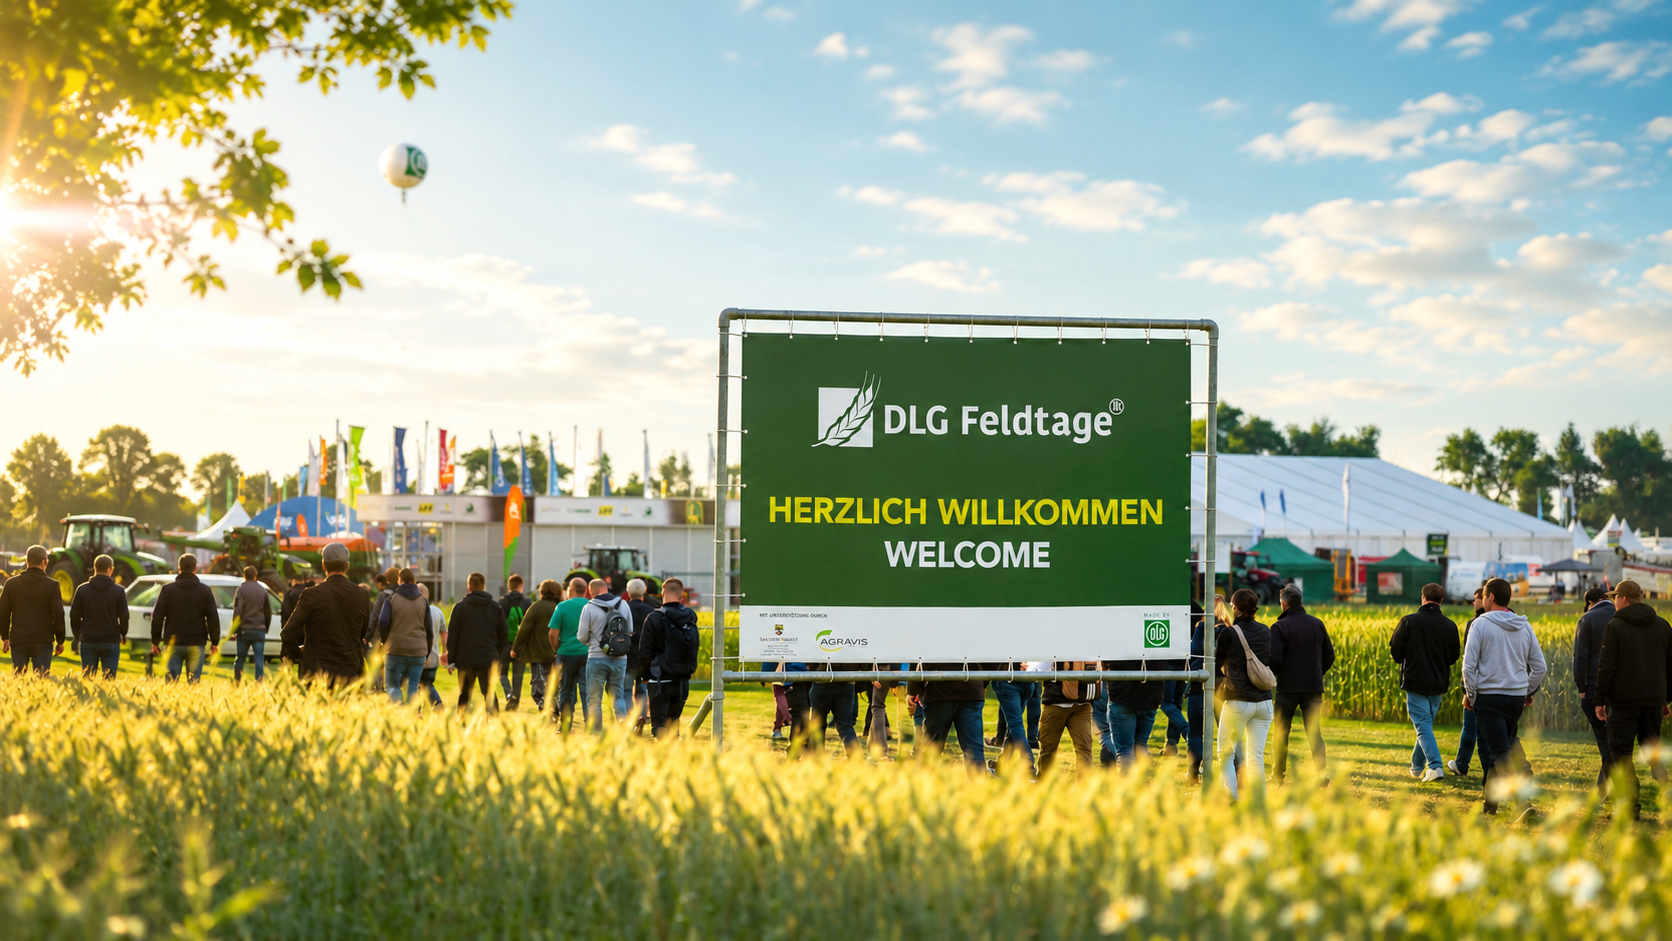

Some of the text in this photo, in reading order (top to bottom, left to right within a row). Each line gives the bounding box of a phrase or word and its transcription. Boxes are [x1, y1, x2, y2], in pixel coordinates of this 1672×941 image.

[884, 404, 1113, 444] DLG Feldtage
[769, 496, 1163, 526] HERZLICH WILLKOMMEN
[884, 540, 1051, 569] WELCOME
[820, 638, 868, 646] AGRAVIS
